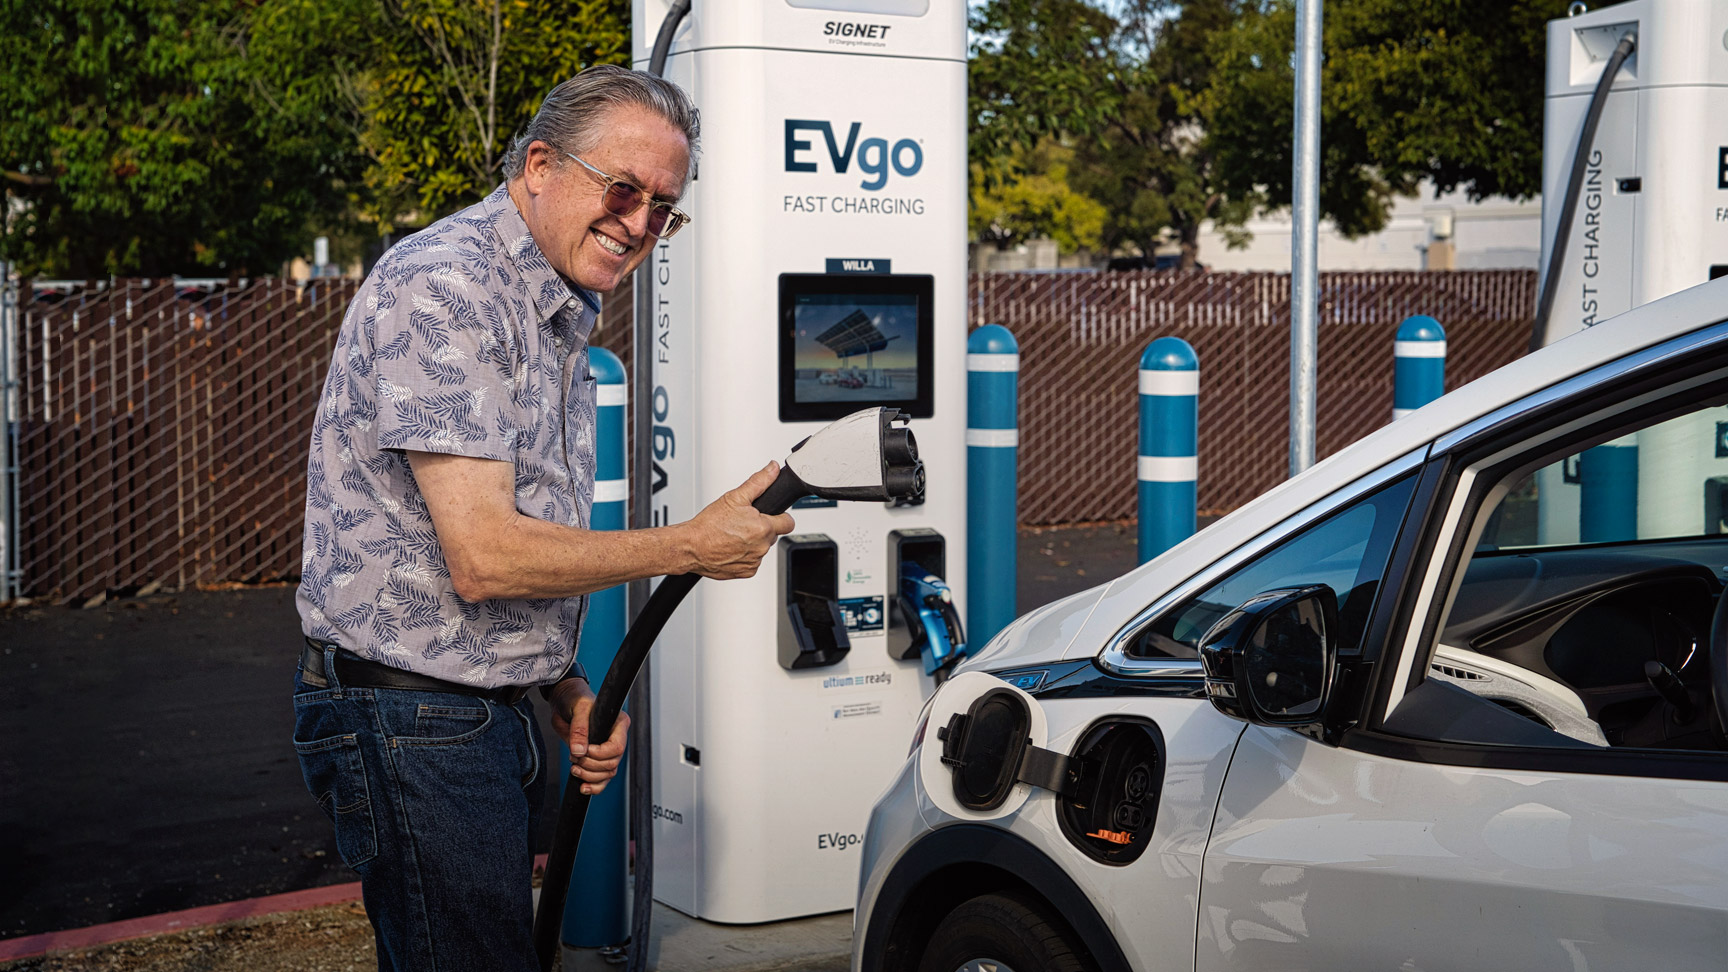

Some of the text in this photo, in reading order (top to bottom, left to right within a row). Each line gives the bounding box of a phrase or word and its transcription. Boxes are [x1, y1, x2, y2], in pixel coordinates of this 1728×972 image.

[823, 21, 892, 40] SIGNET
[784, 118, 923, 192] EVgo
[783, 195, 925, 215] FAST CHARGING
[1582, 150, 1603, 331] AST CHARGING
[842, 260, 875, 271] WILLA
[658, 293, 670, 364] FAST
[865, 671, 892, 685] ready
[1016, 675, 1041, 688] EV
[652, 804, 683, 825] go.com
[817, 832, 864, 851] EVgo.
